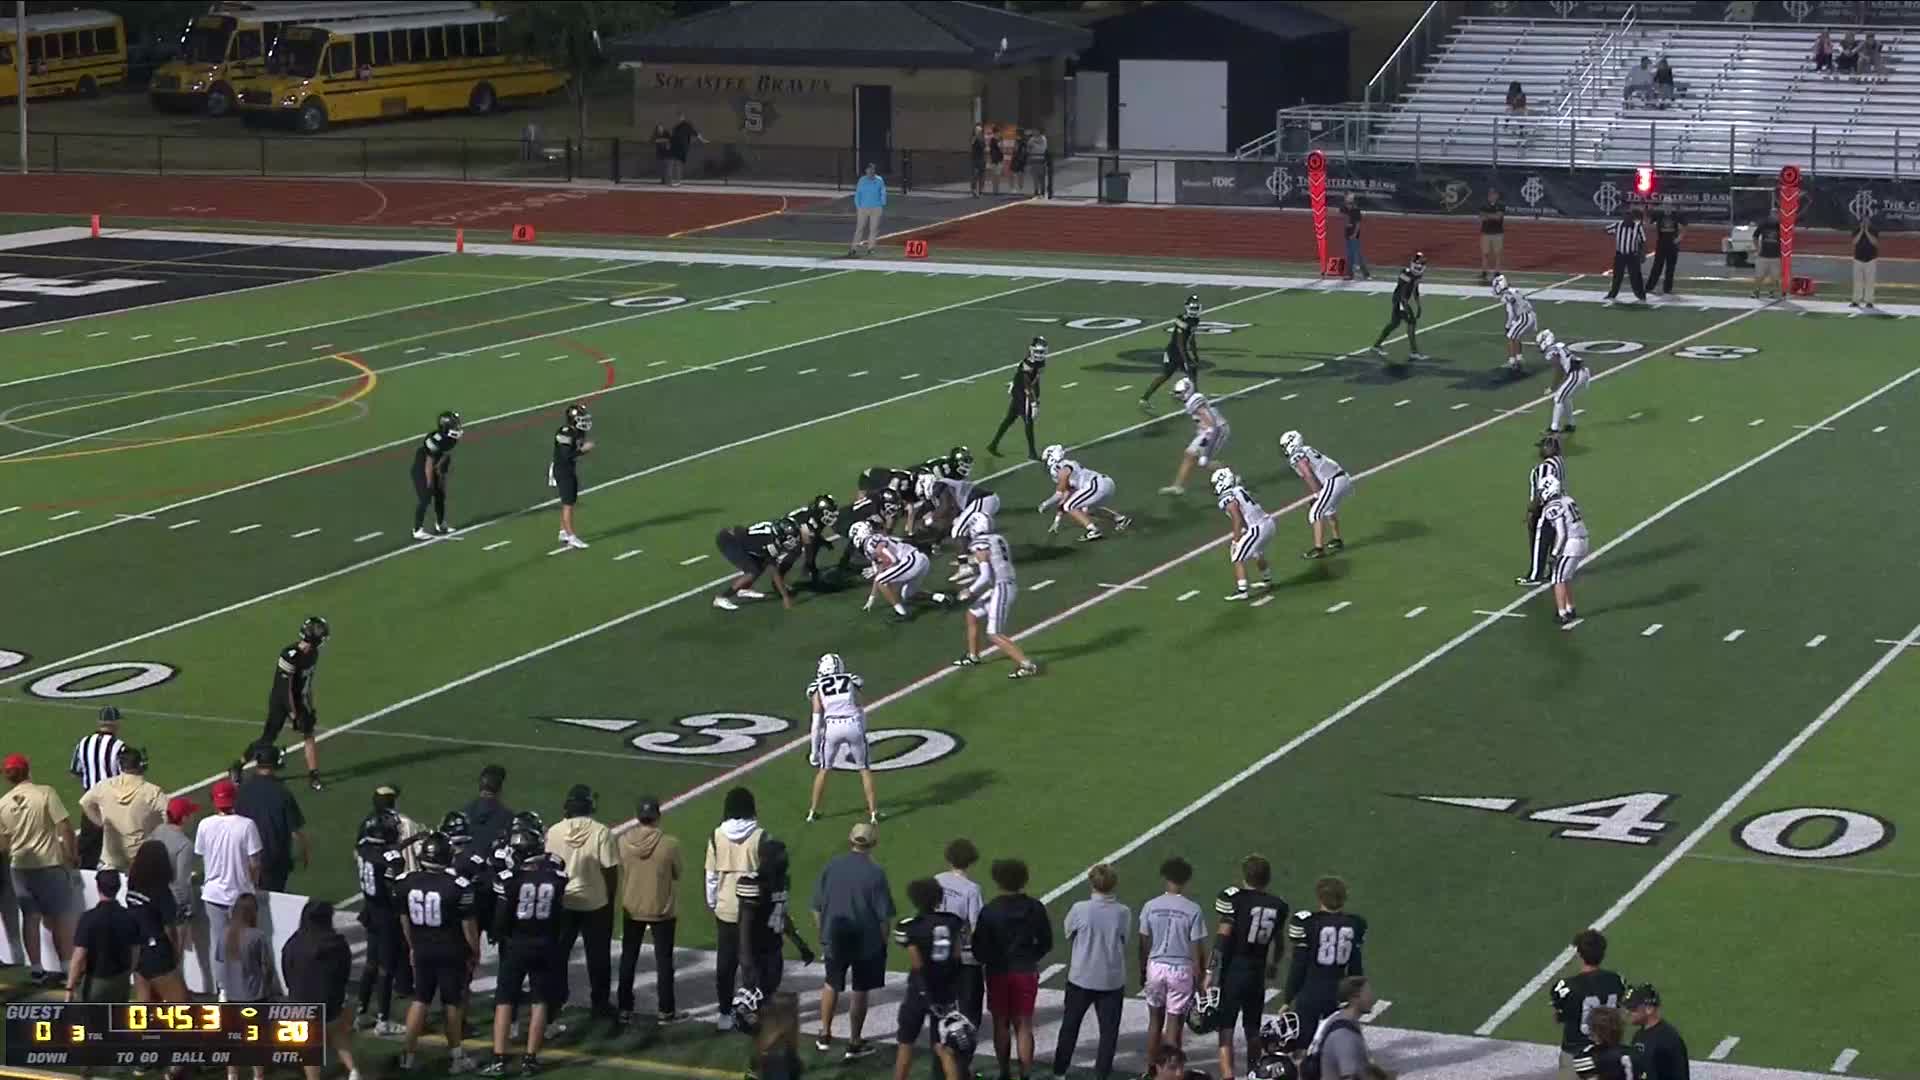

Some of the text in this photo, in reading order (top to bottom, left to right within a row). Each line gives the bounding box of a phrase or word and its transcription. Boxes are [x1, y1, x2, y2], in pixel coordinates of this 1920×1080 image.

[908, 241, 924, 256] 10
[820, 675, 850, 696] 27
[408, 889, 442, 928] 60
[516, 882, 555, 920] 88
[1247, 906, 1278, 944] 15
[1317, 926, 1355, 966] 86
